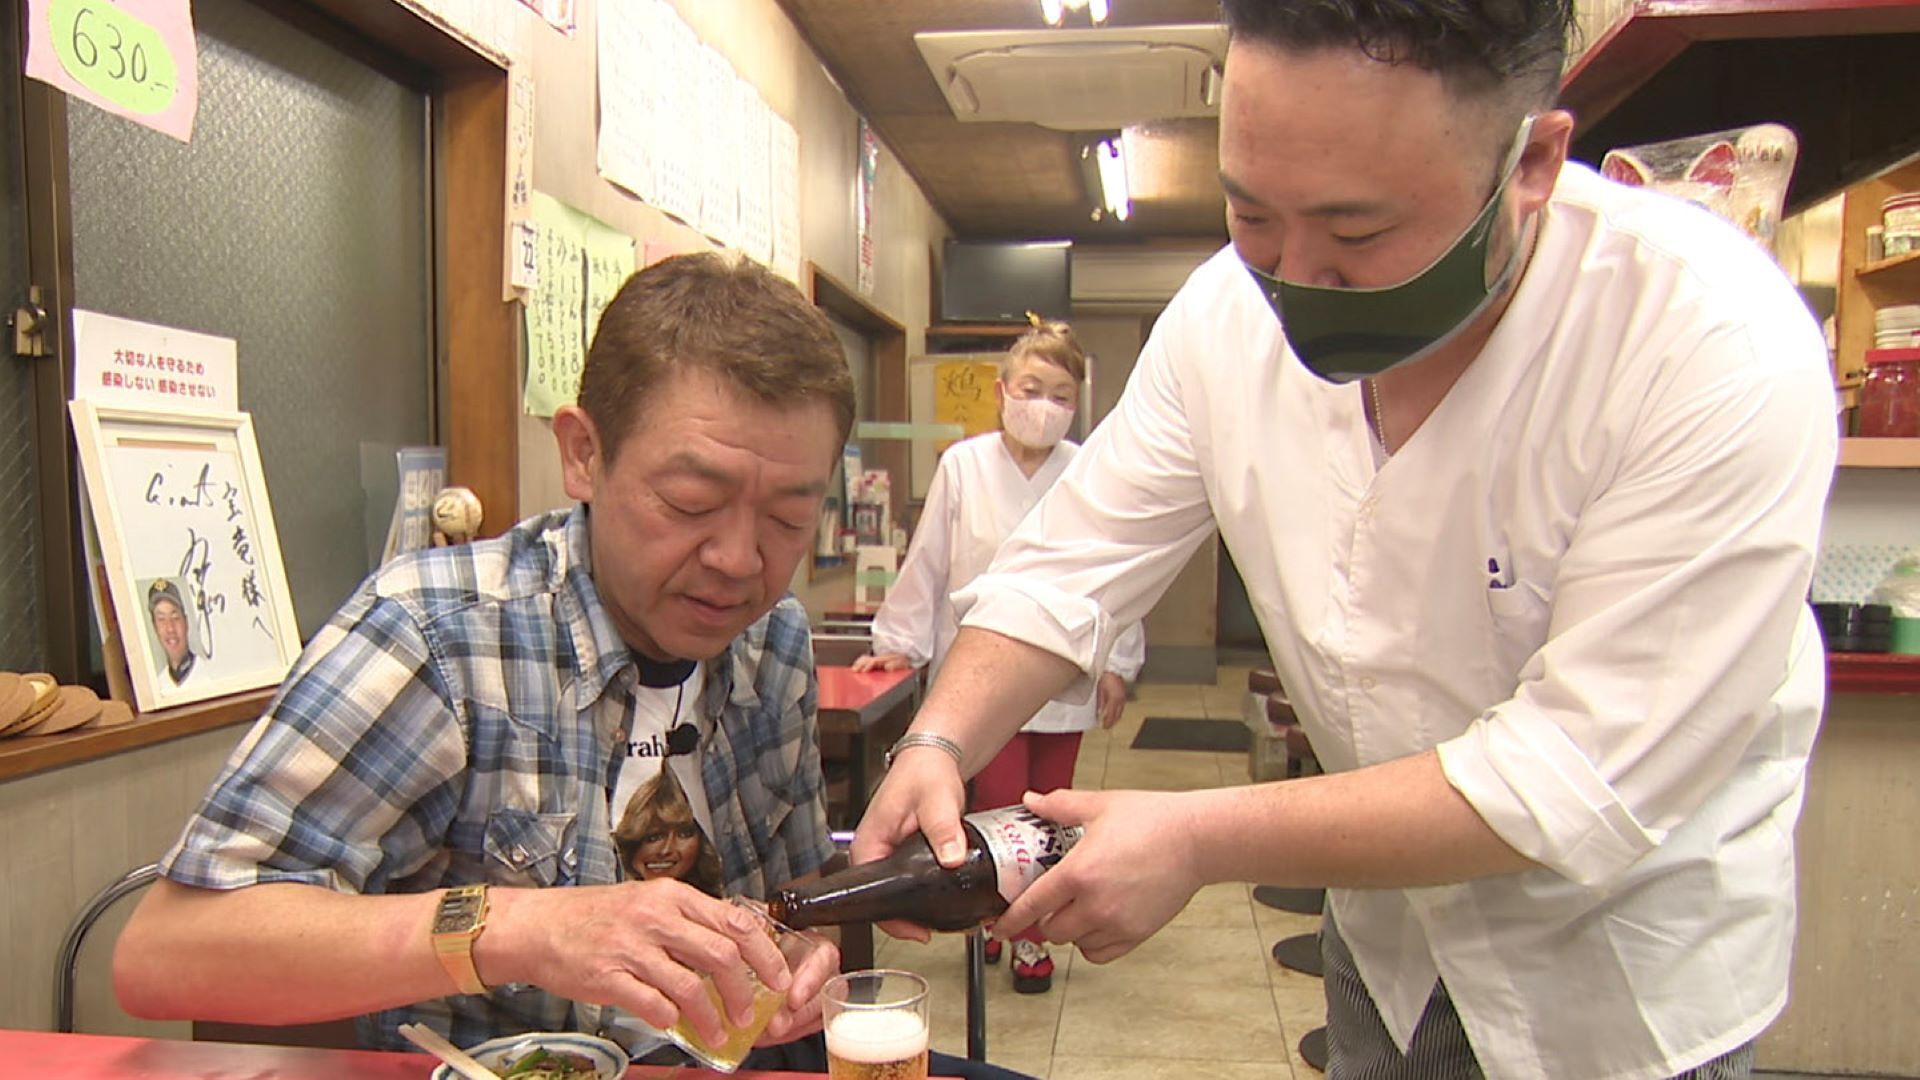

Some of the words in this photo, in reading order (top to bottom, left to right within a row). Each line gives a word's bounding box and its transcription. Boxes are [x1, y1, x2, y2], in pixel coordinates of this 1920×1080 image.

[113, 349, 205, 376] 大切な人を守るため
[101, 371, 155, 391] 感染しない
[158, 378, 216, 399] 感染させない
